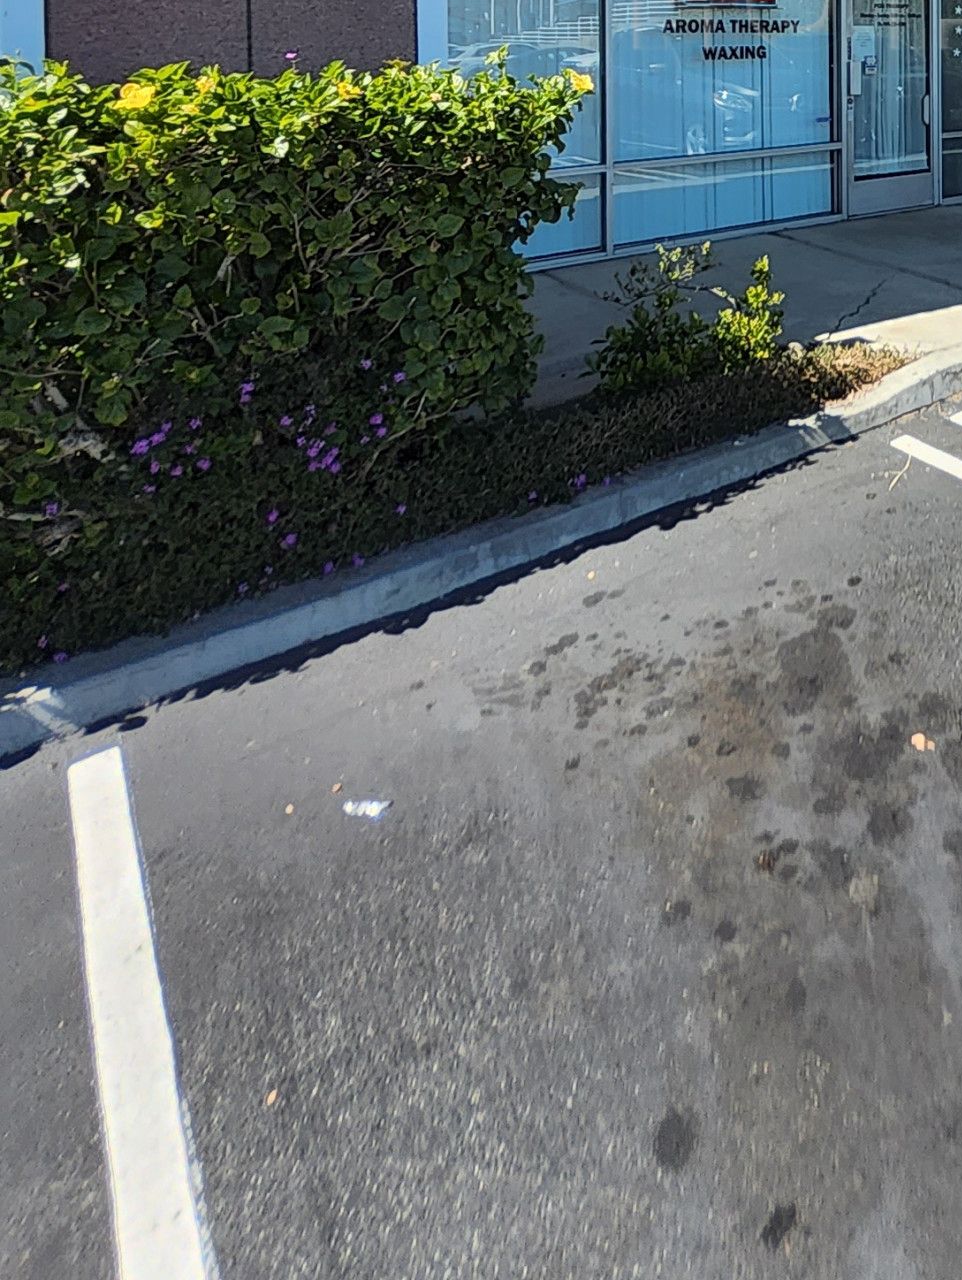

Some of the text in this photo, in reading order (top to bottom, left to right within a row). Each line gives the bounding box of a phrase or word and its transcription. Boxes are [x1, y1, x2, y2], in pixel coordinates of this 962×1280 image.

[663, 18, 800, 35] AROMA THERAPY
[702, 46, 767, 61] WAXING
